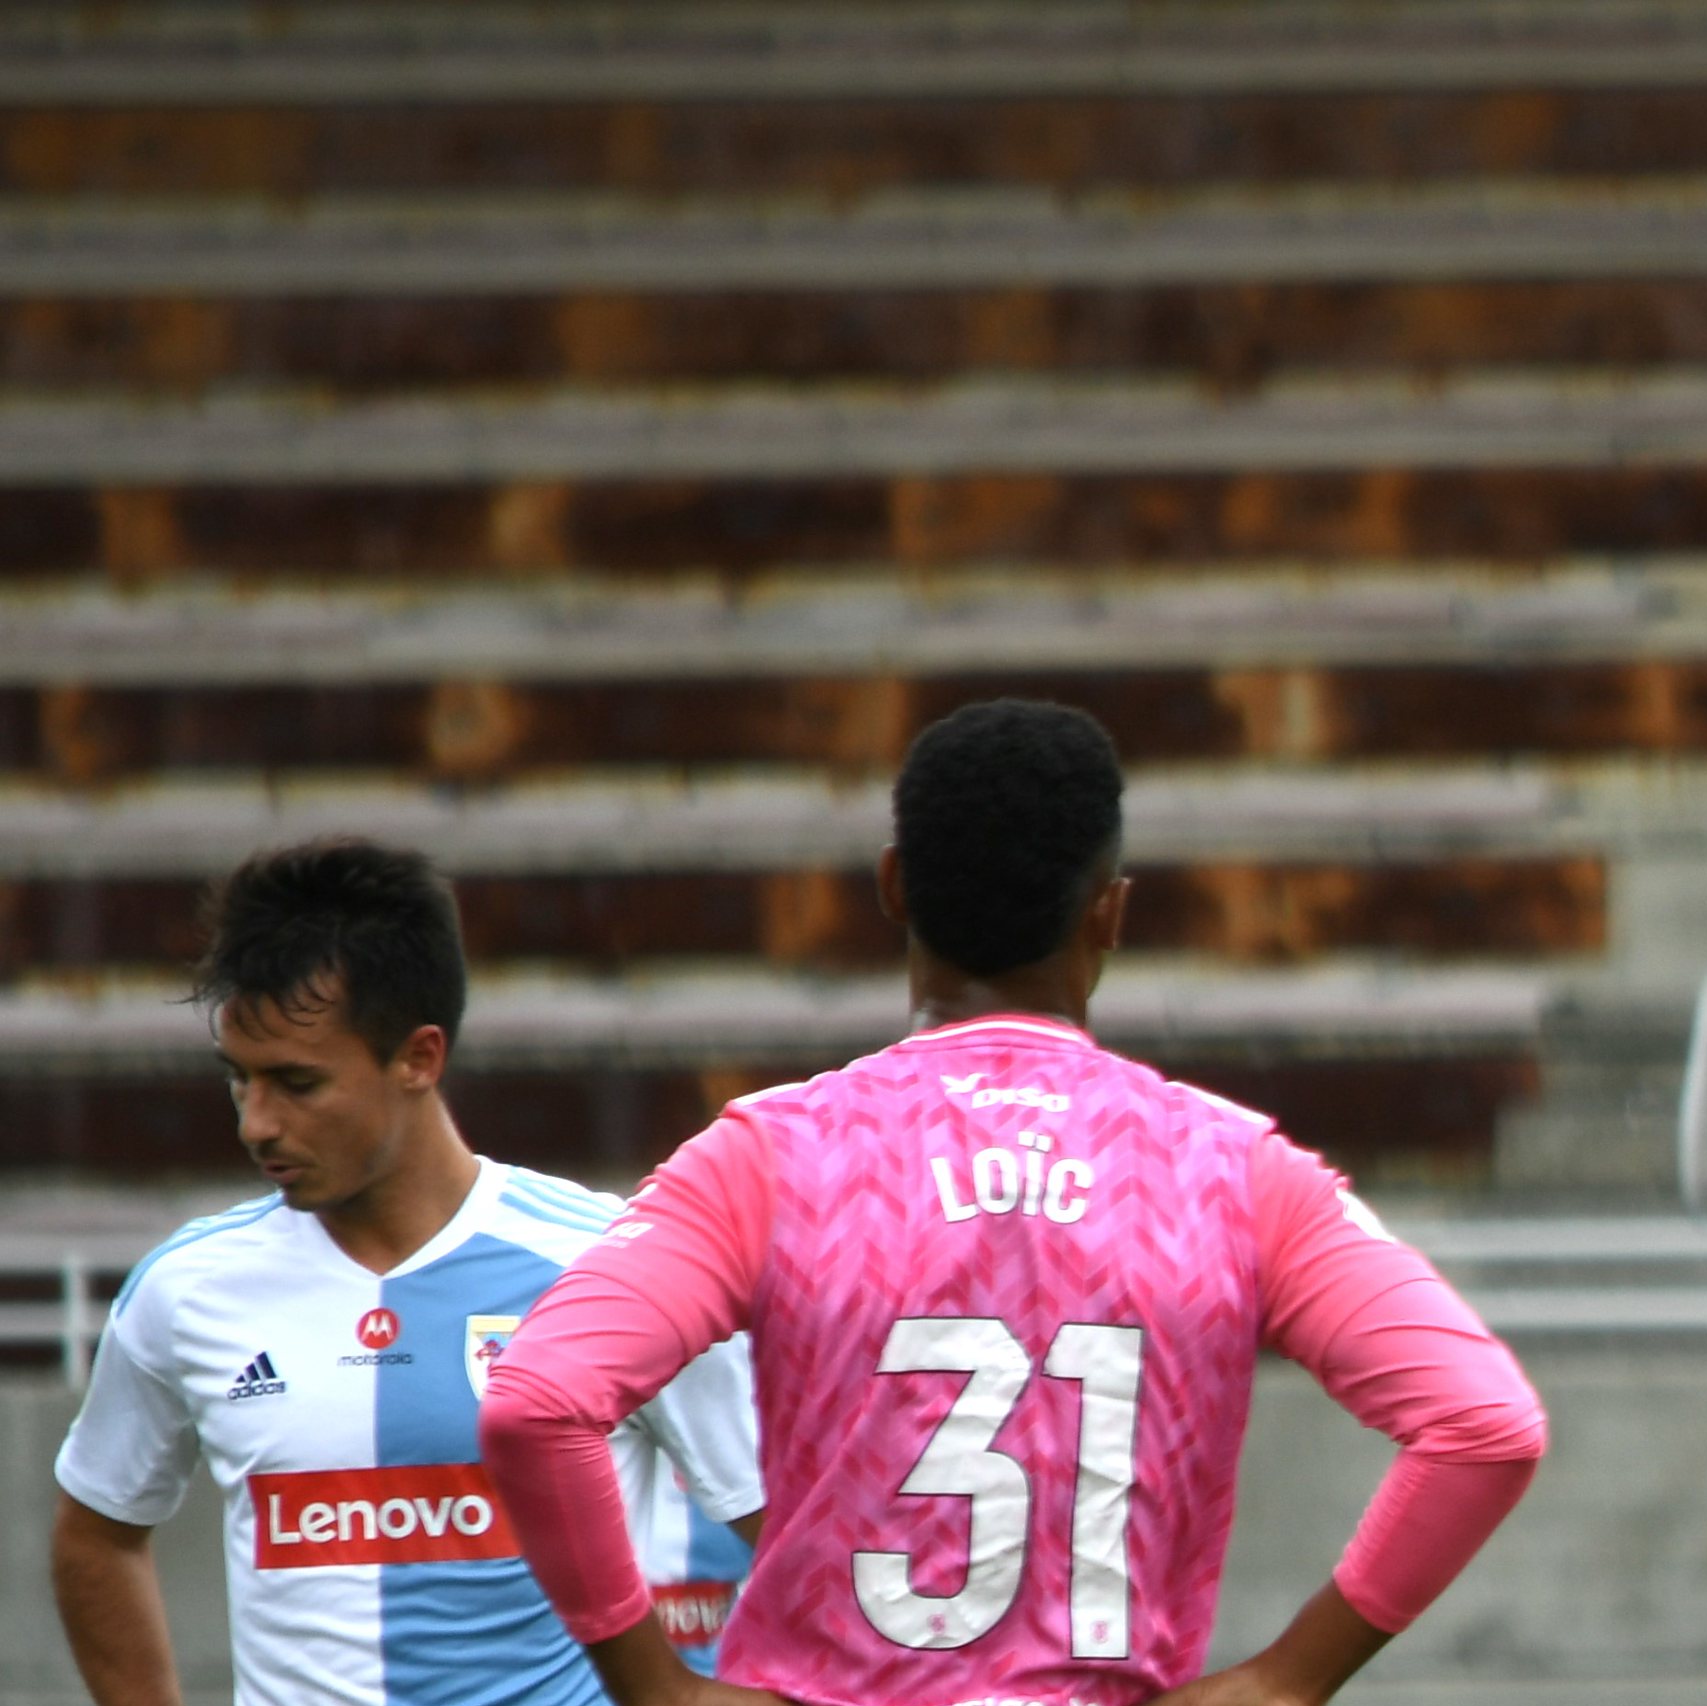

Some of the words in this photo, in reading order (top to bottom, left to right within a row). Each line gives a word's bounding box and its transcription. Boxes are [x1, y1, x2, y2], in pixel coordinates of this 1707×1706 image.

[929, 1130, 1097, 1225] LOÏC
[337, 1351, 413, 1367] motorola
[227, 1379, 286, 1401] adidas
[851, 1316, 1145, 1661] 31
[268, 1494, 493, 1545] Lenovo
